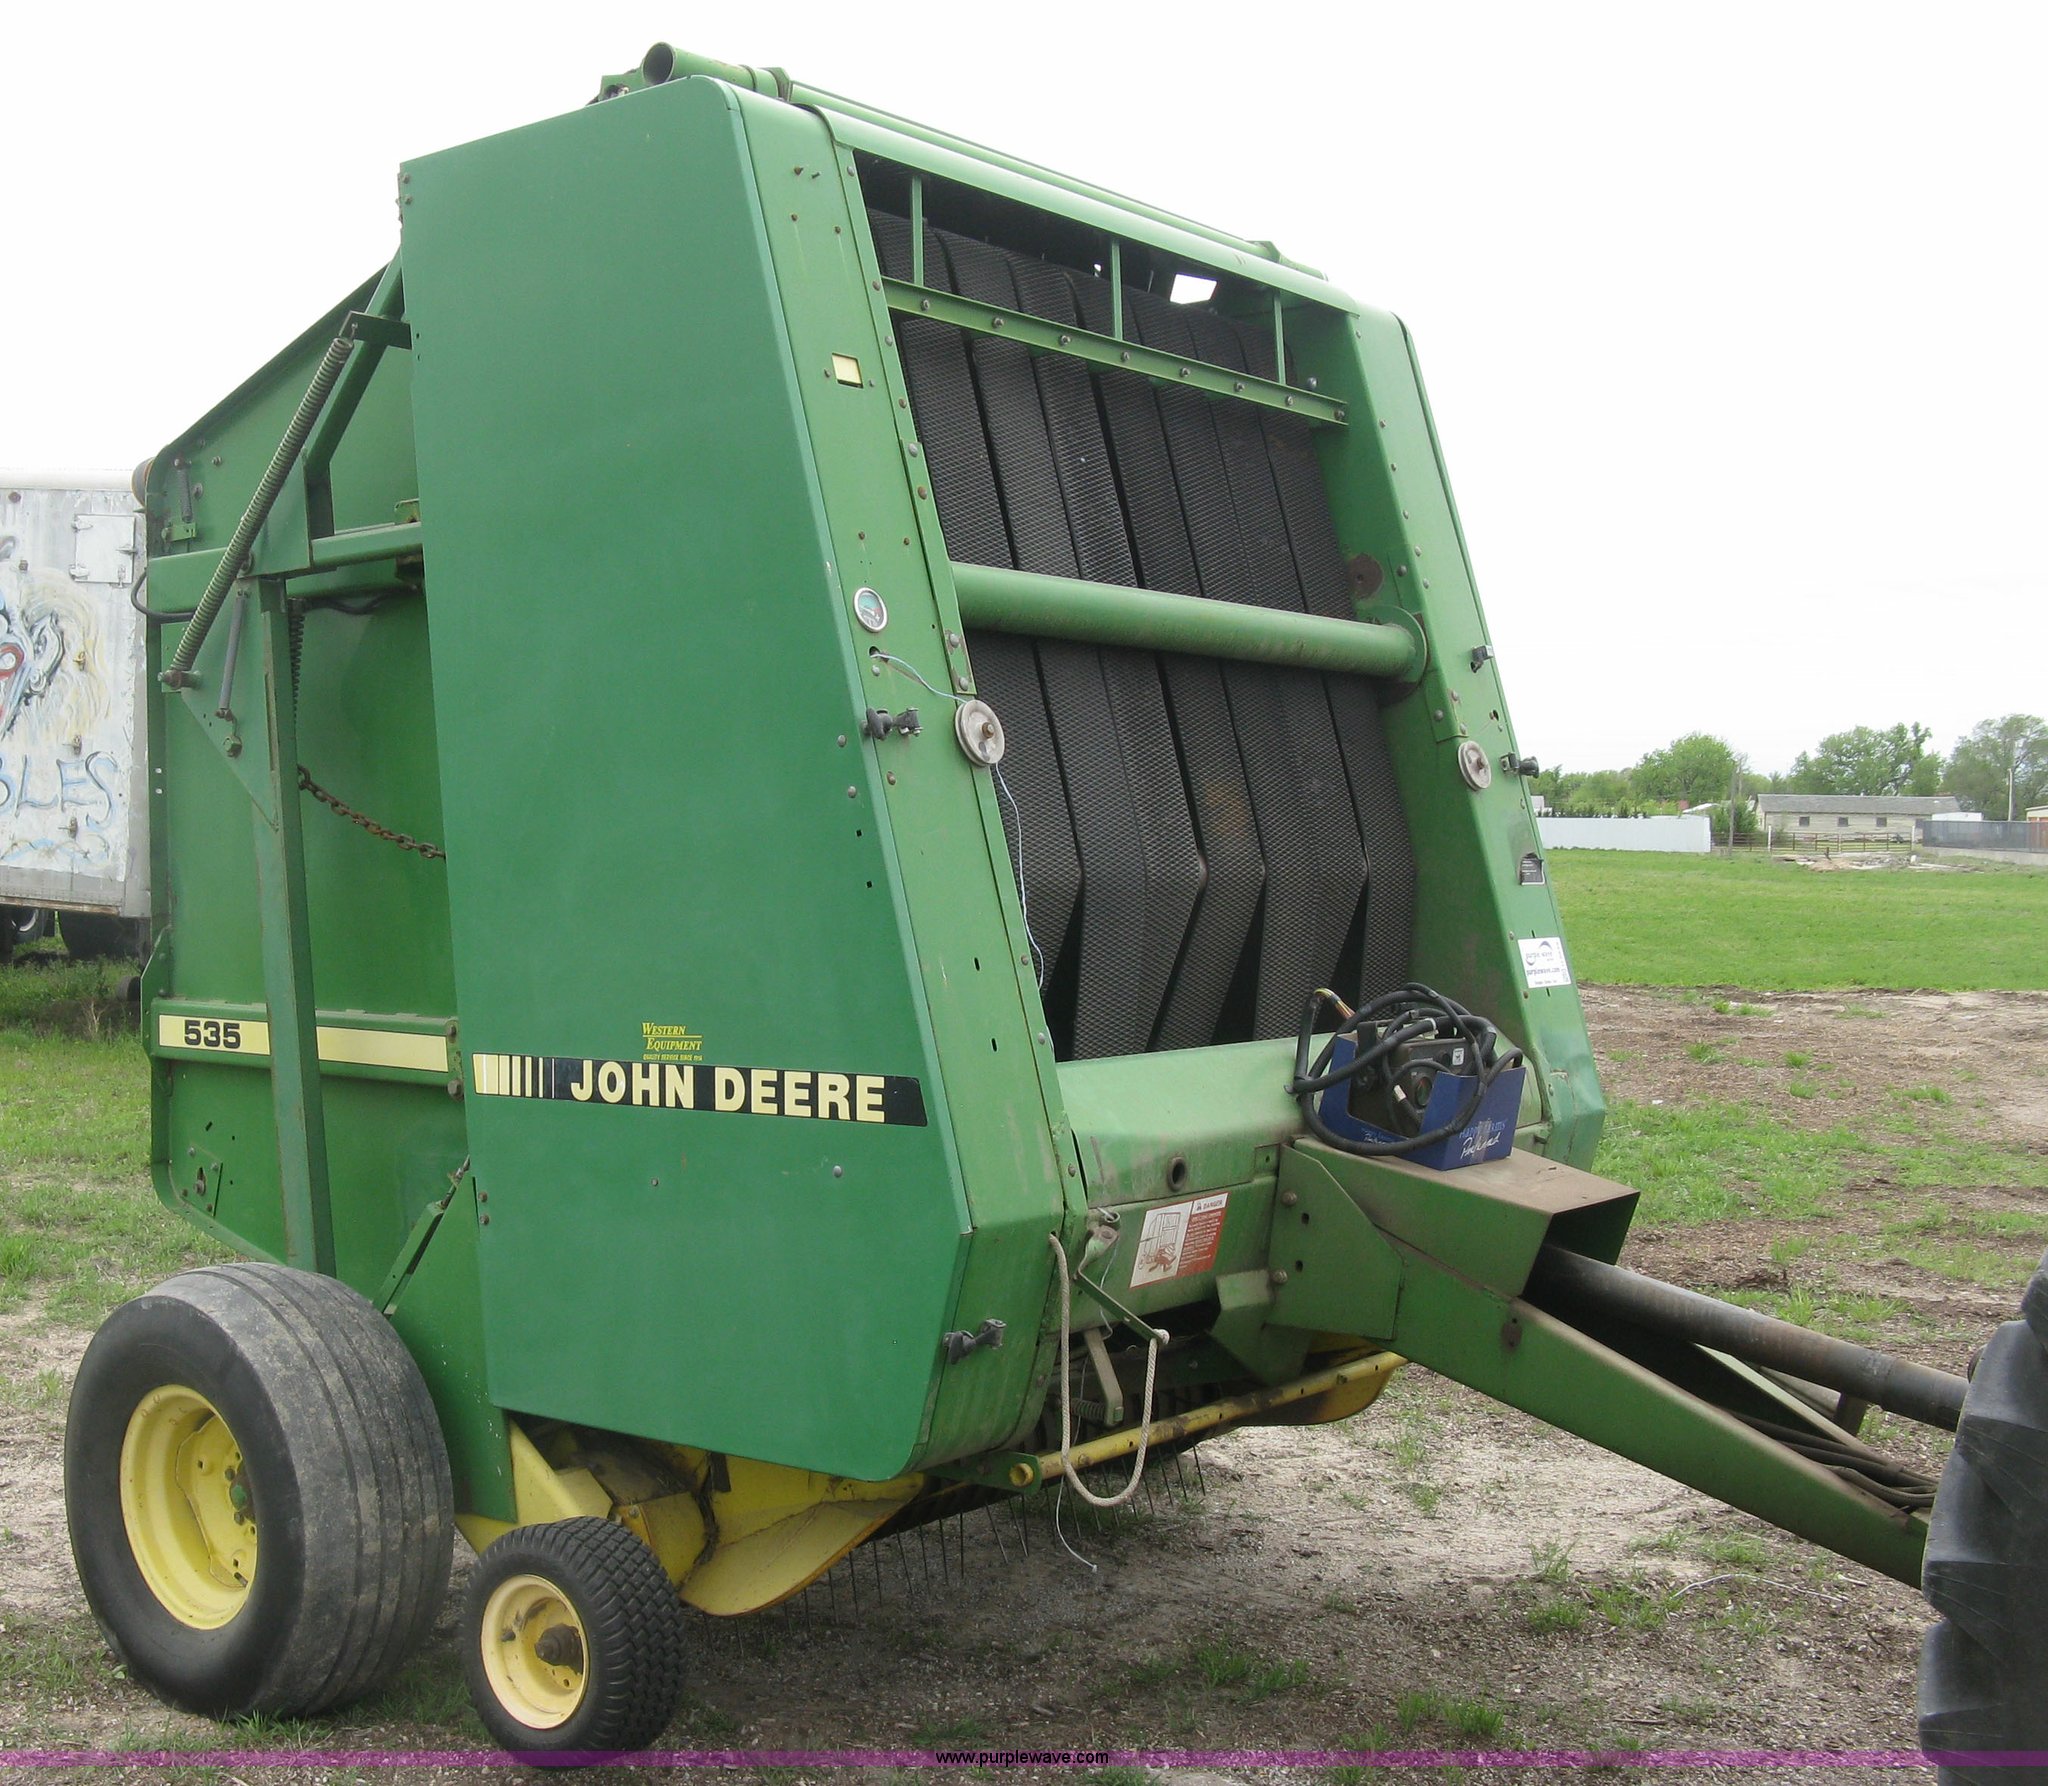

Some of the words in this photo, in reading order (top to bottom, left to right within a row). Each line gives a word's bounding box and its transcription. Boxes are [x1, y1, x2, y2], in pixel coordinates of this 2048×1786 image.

[184, 1019, 241, 1049] 535
[642, 1022, 686, 1035] WESTERN
[646, 1037, 703, 1052] EQUIPMENT
[570, 1059, 695, 1110] JOHN
[714, 1066, 886, 1124] DEERE
